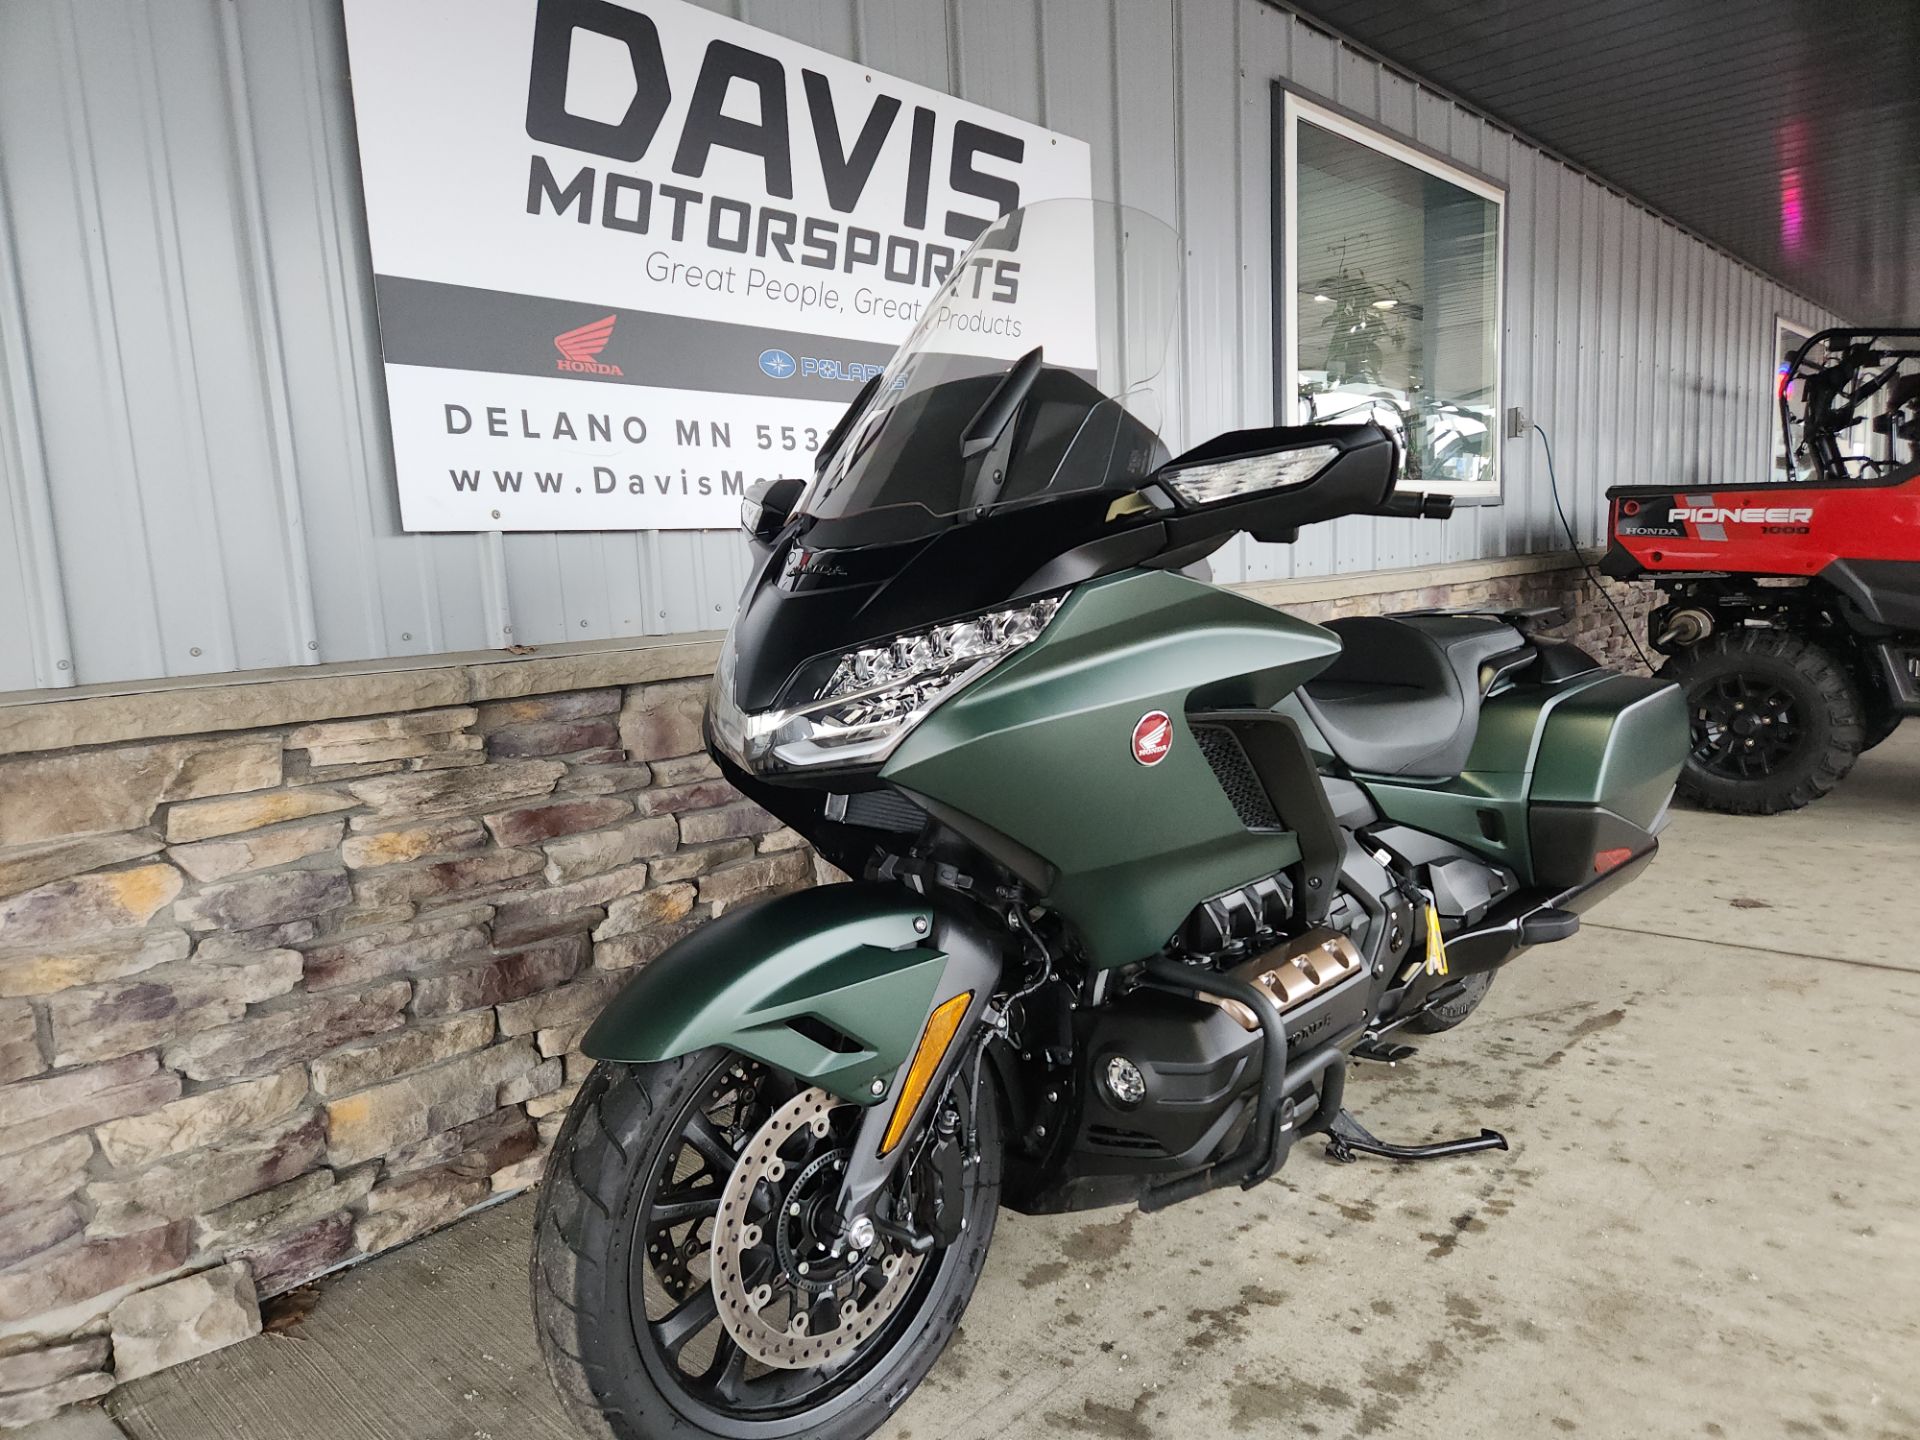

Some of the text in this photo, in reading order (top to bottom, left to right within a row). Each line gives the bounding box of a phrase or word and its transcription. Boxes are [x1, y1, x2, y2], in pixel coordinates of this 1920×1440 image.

[526, 0, 1025, 251] DAVIS
[526, 155, 1021, 304] MOTORSPORTS
[645, 250, 1022, 338] Great People, Great Products
[556, 359, 624, 377] HONDA
[800, 356, 908, 390] POLARS
[444, 404, 833, 451] DELANO MN 553
[449, 466, 783, 496] www.DavisM
[1625, 527, 1679, 536] HONDA
[1668, 507, 1814, 524] PIONEER
[1760, 525, 1811, 535] 1000
